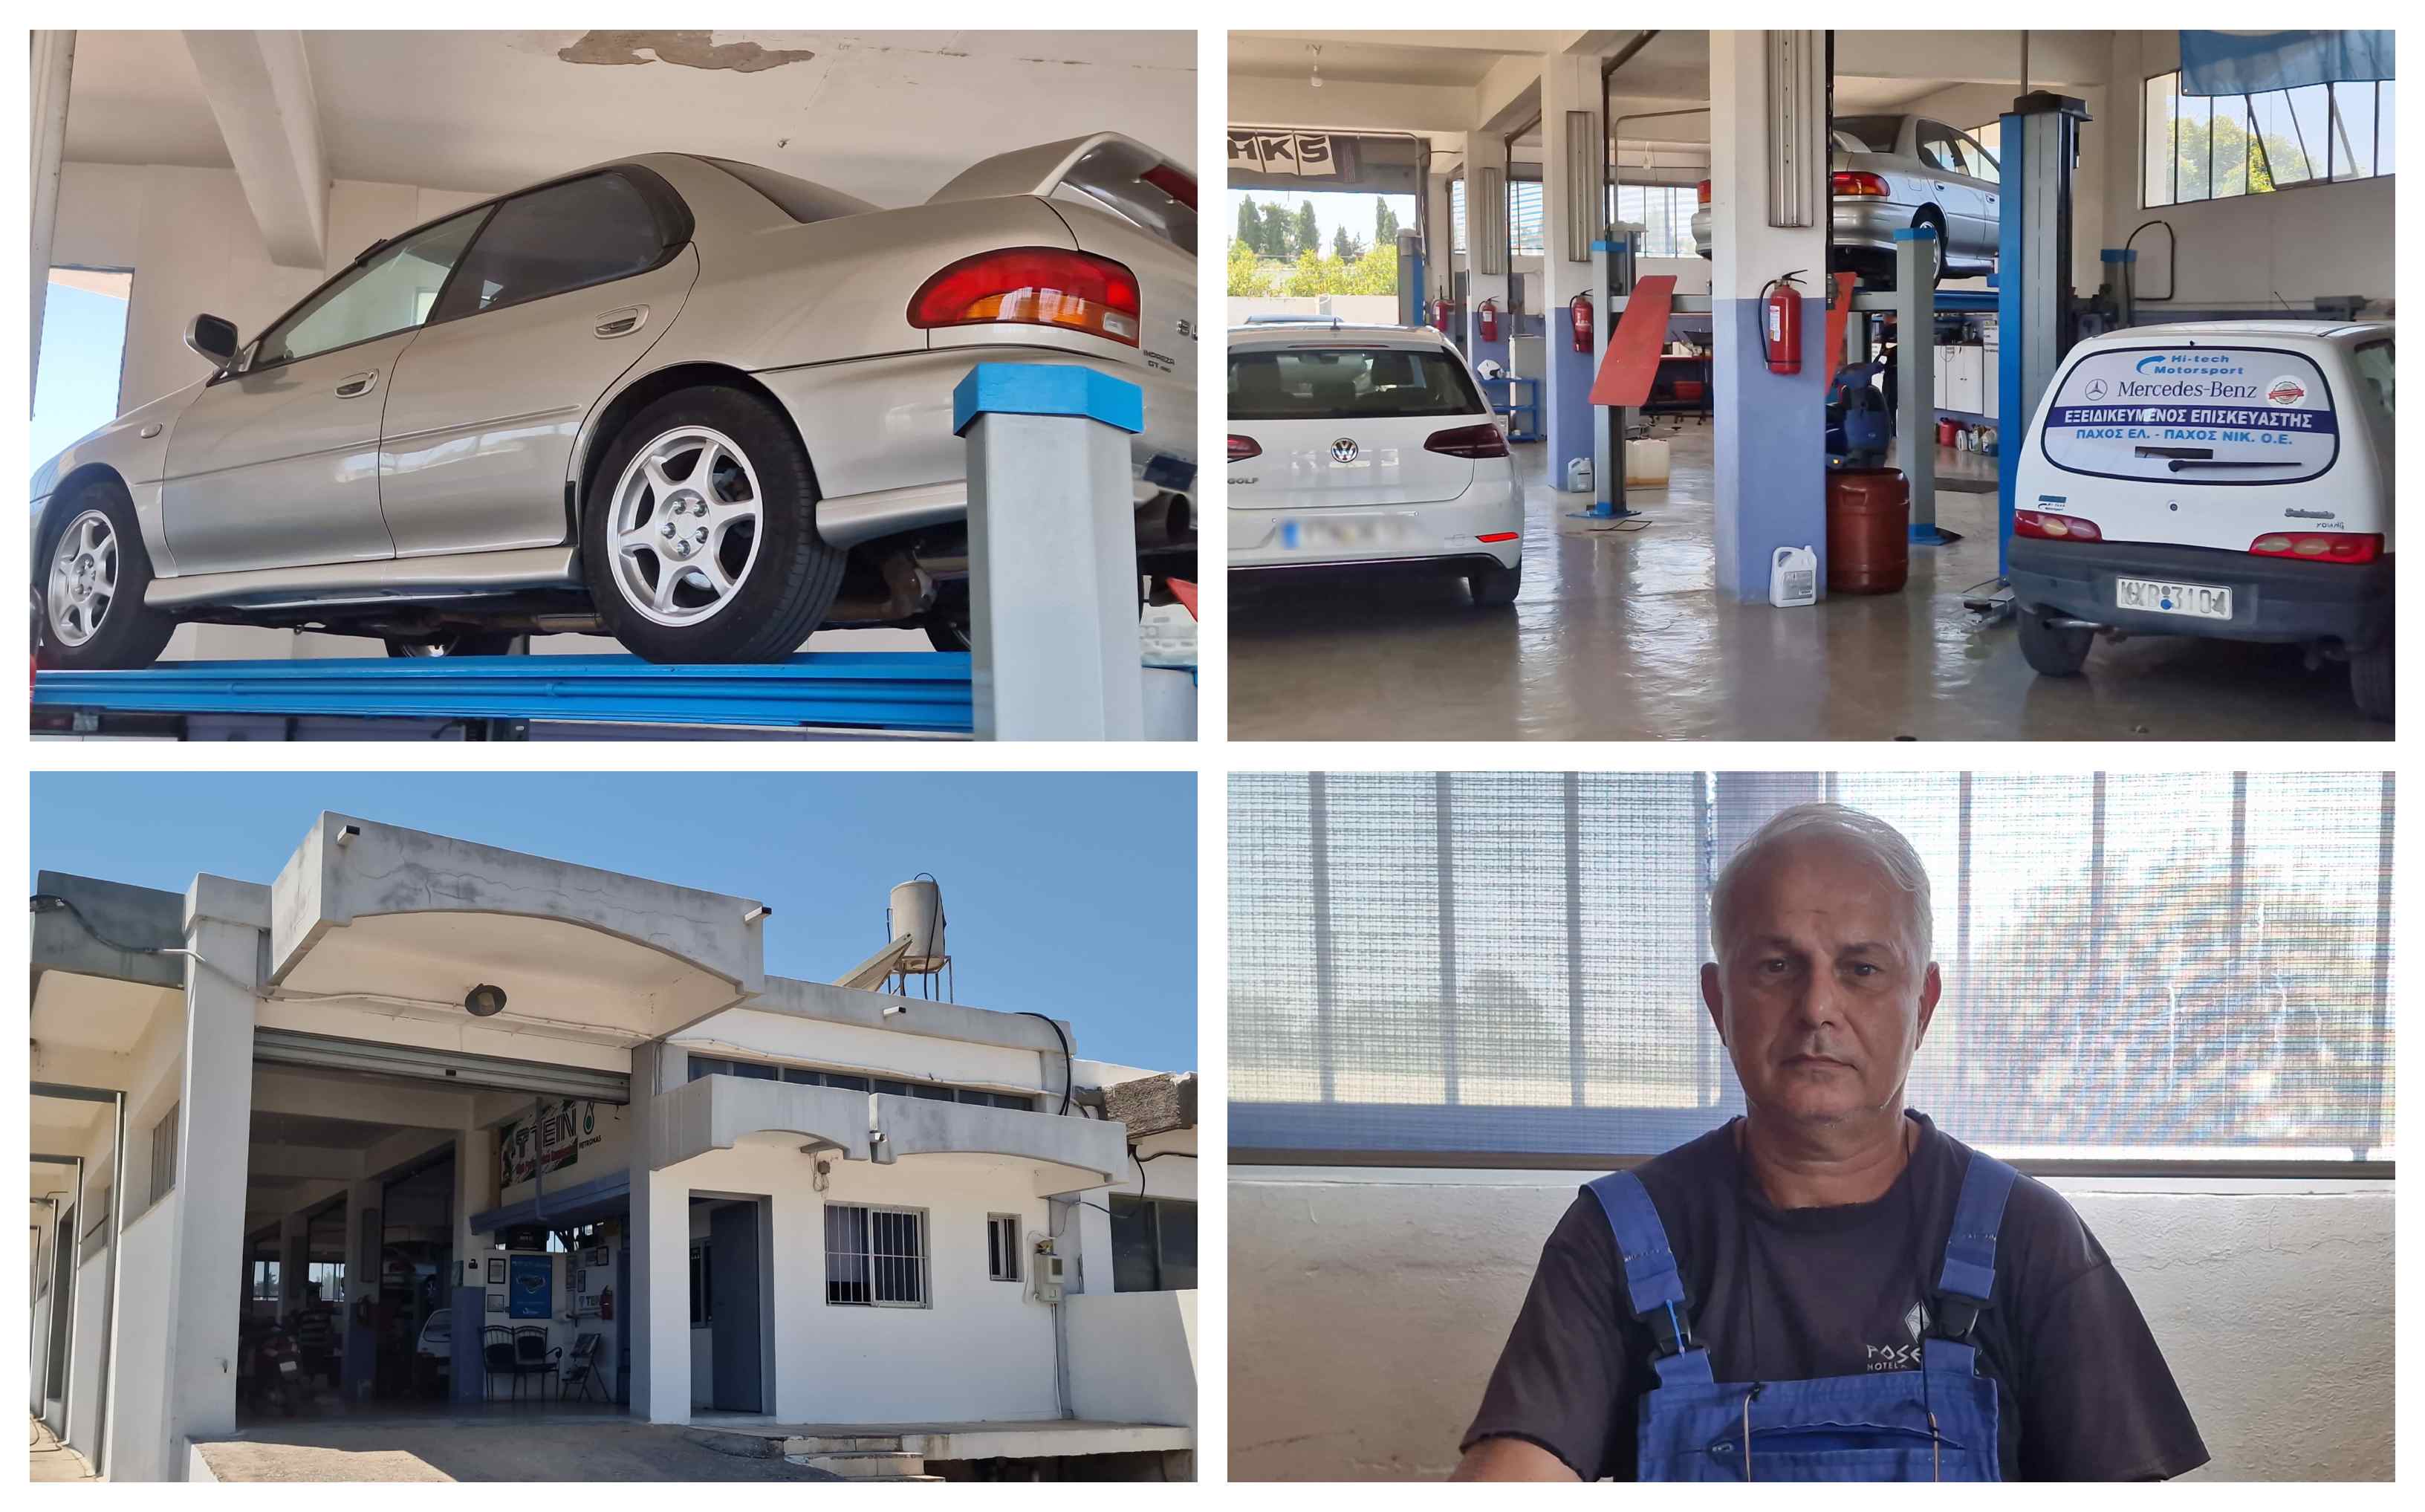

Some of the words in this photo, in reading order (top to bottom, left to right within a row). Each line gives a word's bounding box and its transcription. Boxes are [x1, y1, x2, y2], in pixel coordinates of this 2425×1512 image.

[1227, 136, 1329, 163] HKS
[2171, 355, 2229, 363] Hi-tech
[2154, 366, 2244, 375] Motorsport
[2117, 380, 2258, 399] Mercedes-Benz
[2191, 409, 2313, 429] ΕΠΙΣΚΕΥΑΣΤΗΣ
[2076, 429, 2124, 439] ΠΑΧΟΣ
[2163, 429, 2218, 441] ΠΑΧΟΣ
